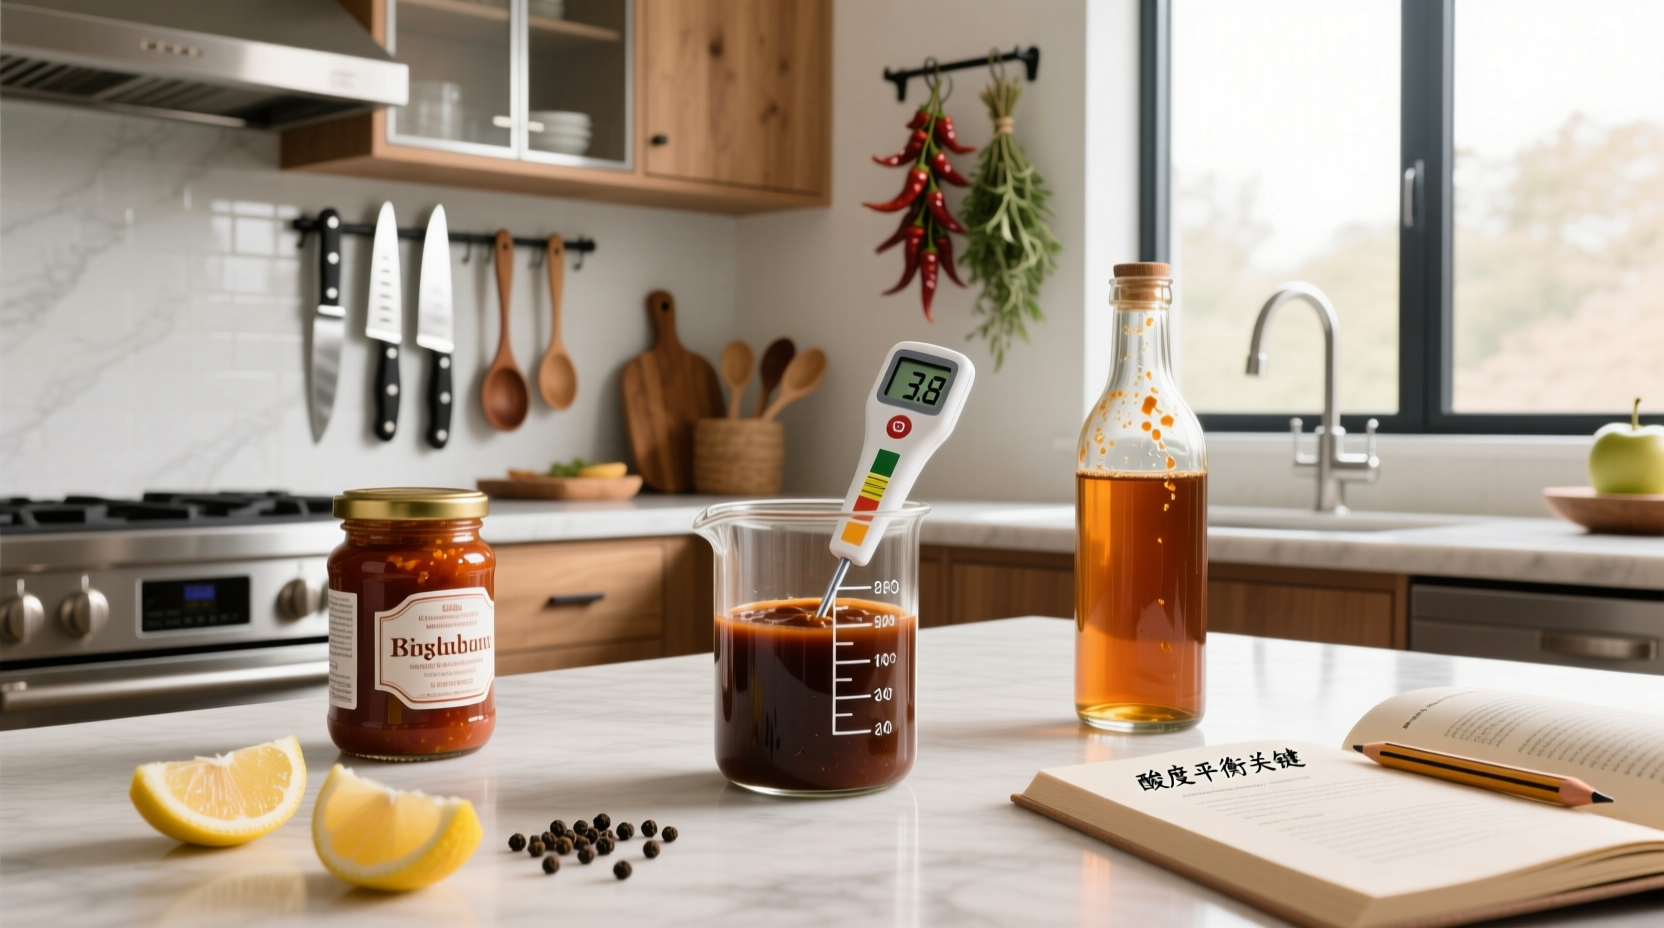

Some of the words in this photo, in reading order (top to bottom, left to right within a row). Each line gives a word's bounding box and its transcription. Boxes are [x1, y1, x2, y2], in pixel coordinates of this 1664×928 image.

[902, 371, 947, 406] 3.8
[1135, 747, 1307, 792] 酸度平衡关键
